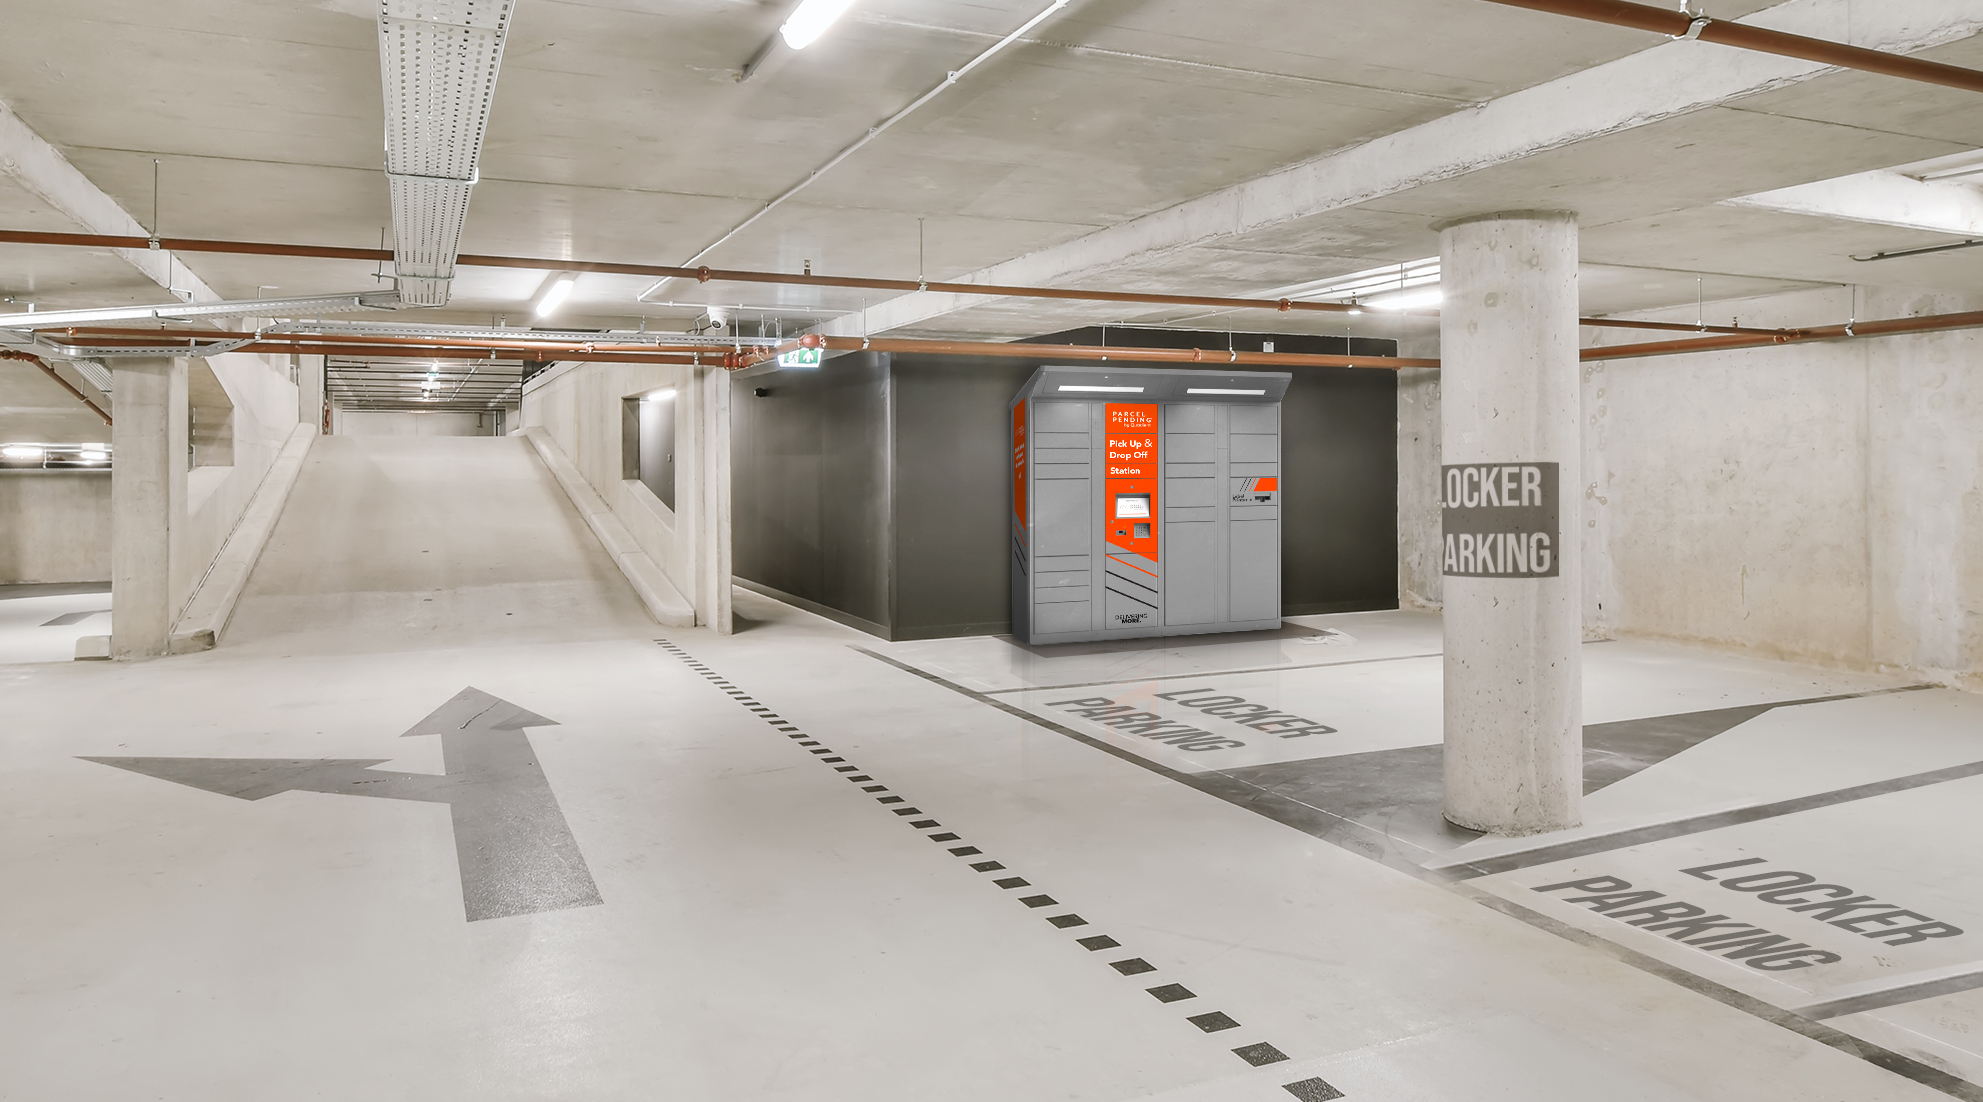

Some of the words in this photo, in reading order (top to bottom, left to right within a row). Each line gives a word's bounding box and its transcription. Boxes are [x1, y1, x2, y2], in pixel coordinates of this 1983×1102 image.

[1109, 451, 1132, 461] Drop
[1133, 451, 1148, 459] Off
[1110, 440, 1128, 448] Pick
[1130, 440, 1142, 450] Up
[1144, 438, 1153, 448] &
[1110, 466, 1140, 474] Station
[1442, 532, 1551, 573] ARKING
[1044, 696, 1246, 752] PARKING
[1152, 688, 1338, 739] LOCKER
[1529, 875, 1842, 971] PARKING
[1678, 857, 1964, 946] LOCKER
